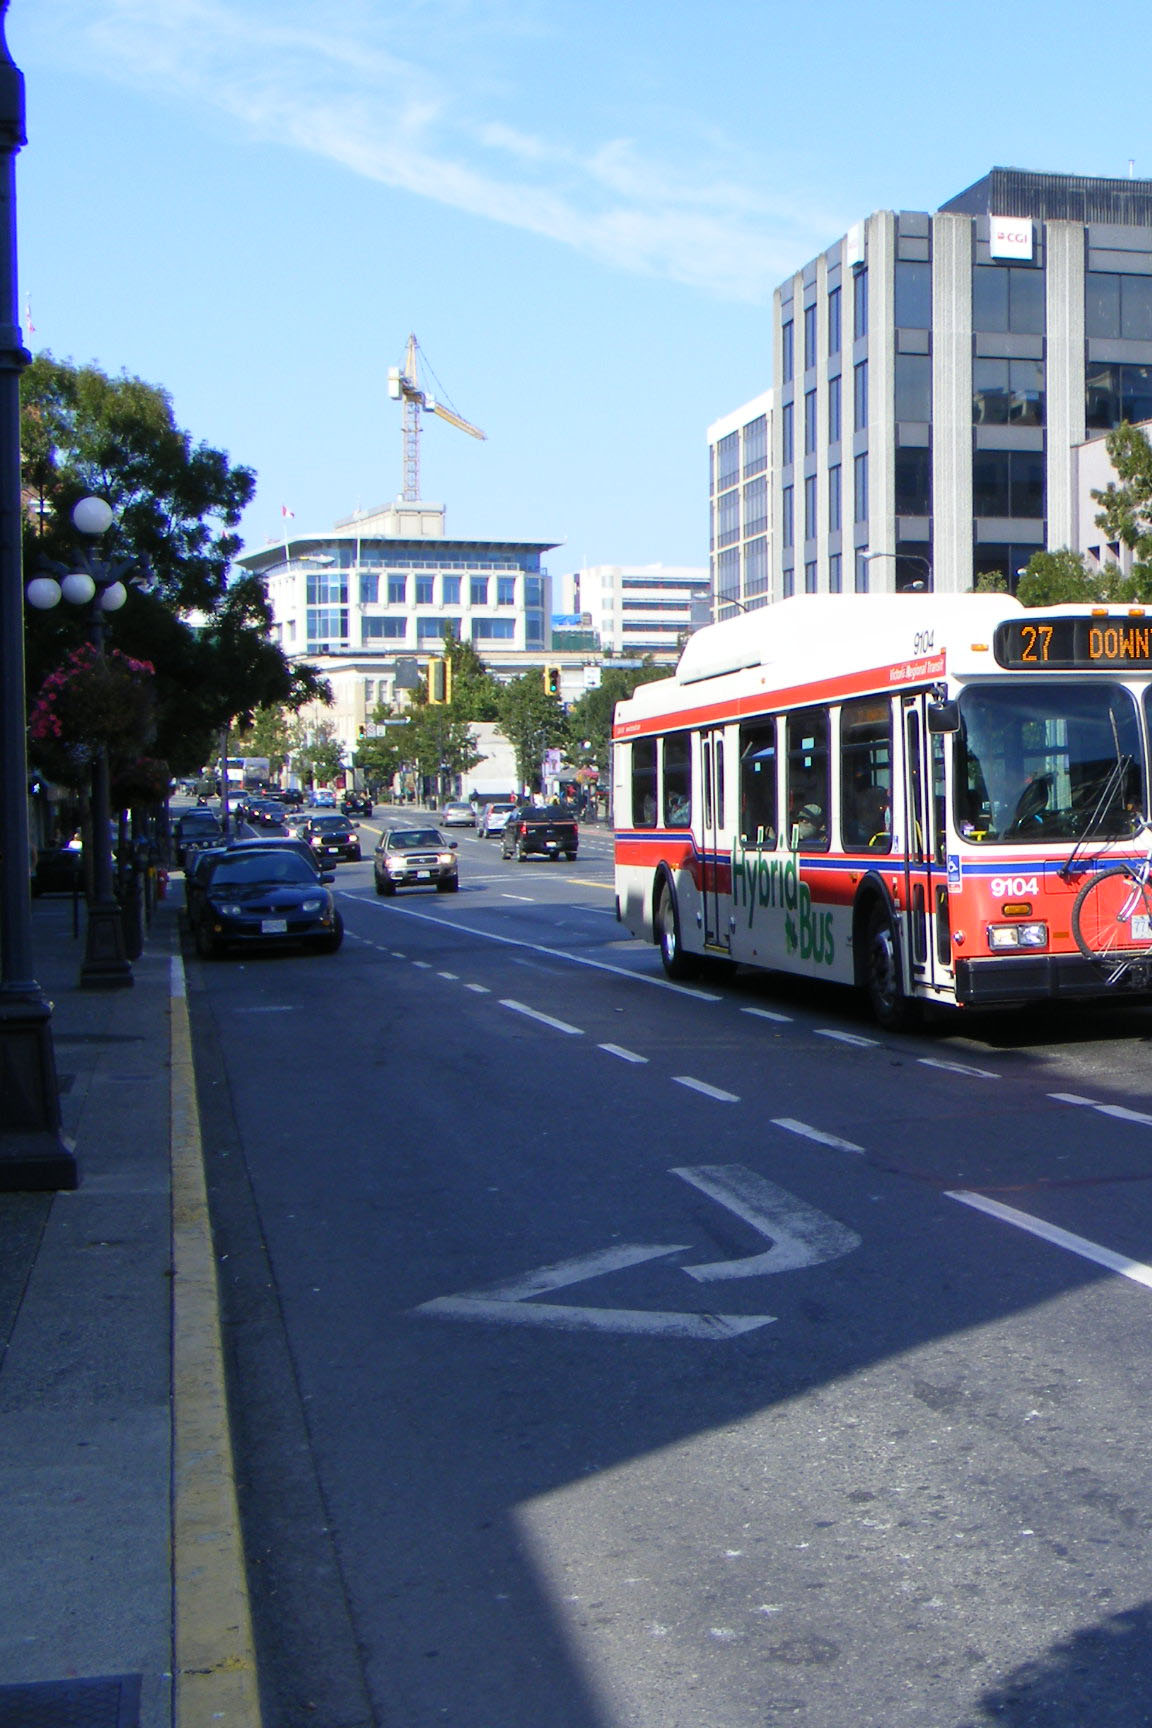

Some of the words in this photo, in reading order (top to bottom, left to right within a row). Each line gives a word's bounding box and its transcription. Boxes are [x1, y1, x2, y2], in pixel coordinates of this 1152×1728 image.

[1007, 232, 1027, 244] CGI
[913, 629, 935, 656] 9104
[1021, 626, 1053, 662] 27
[904, 660, 927, 681] Regional
[926, 658, 945, 673] Transit
[732, 824, 799, 929] Hybrid
[990, 877, 1039, 897] 9104
